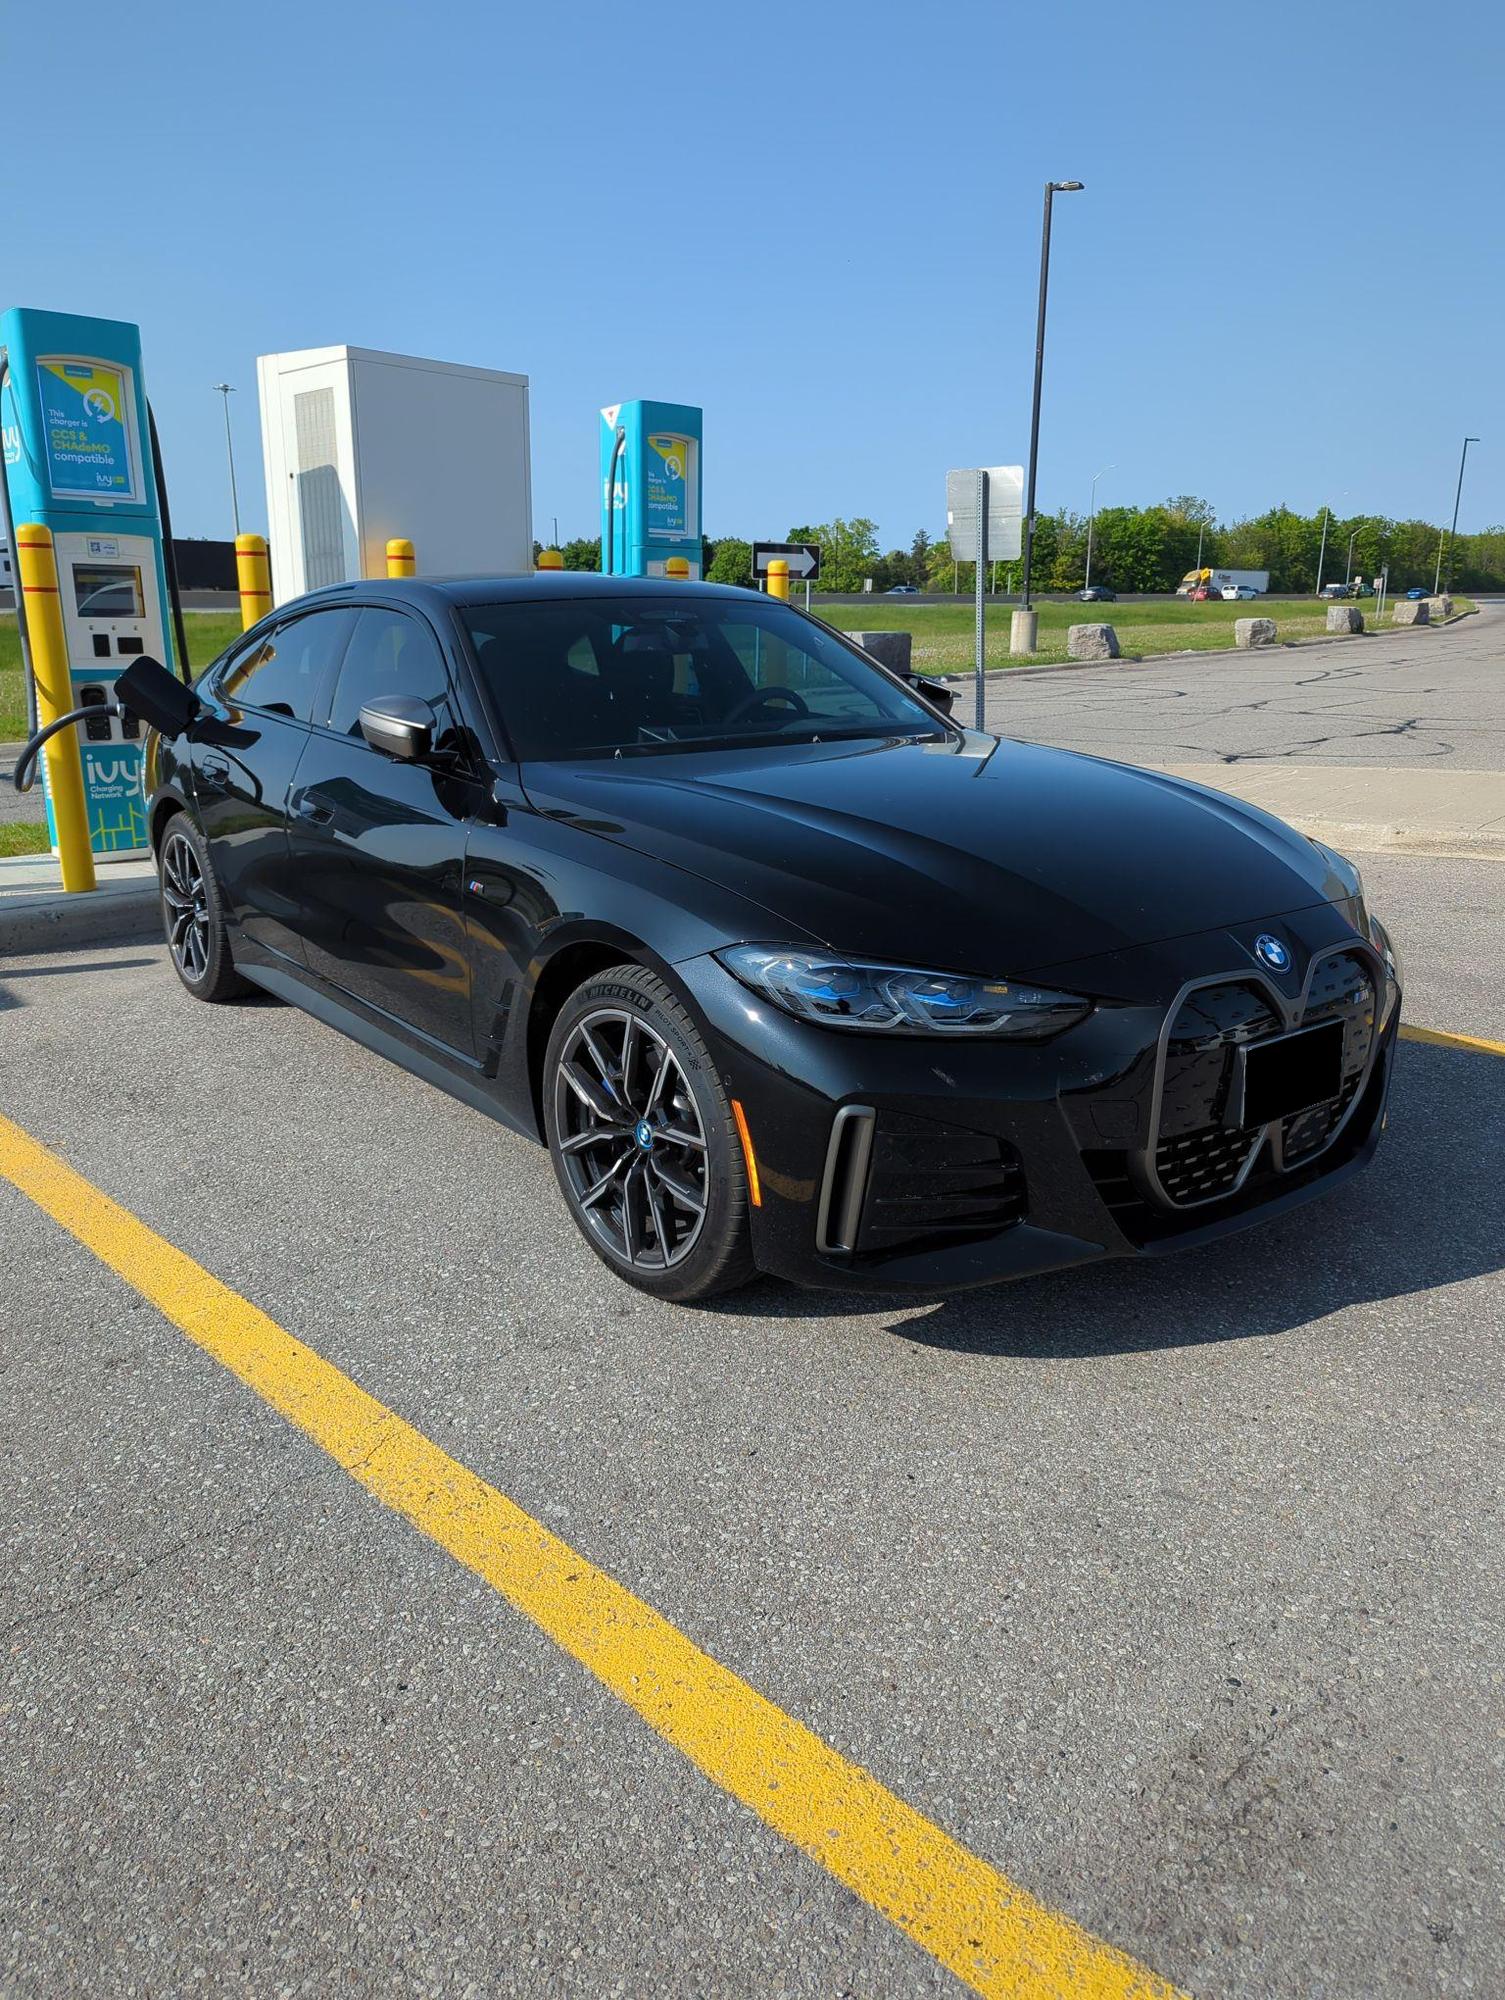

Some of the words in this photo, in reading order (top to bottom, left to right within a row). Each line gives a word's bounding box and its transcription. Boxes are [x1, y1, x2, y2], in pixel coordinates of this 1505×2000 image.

[48, 409, 64, 418] This
[49, 418, 79, 428] charger
[51, 429, 76, 440] CCS
[79, 431, 87, 441] &
[52, 440, 111, 454] CHAdeMO
[54, 452, 115, 465] compatible
[96, 472, 113, 487] ivy
[86, 754, 140, 797] ivy
[90, 785, 123, 793] Charging
[91, 792, 122, 800] Network
[590, 985, 650, 1010] MICHELIN
[655, 1009, 672, 1027] PILOT
[670, 1027, 690, 1051] SPORT
